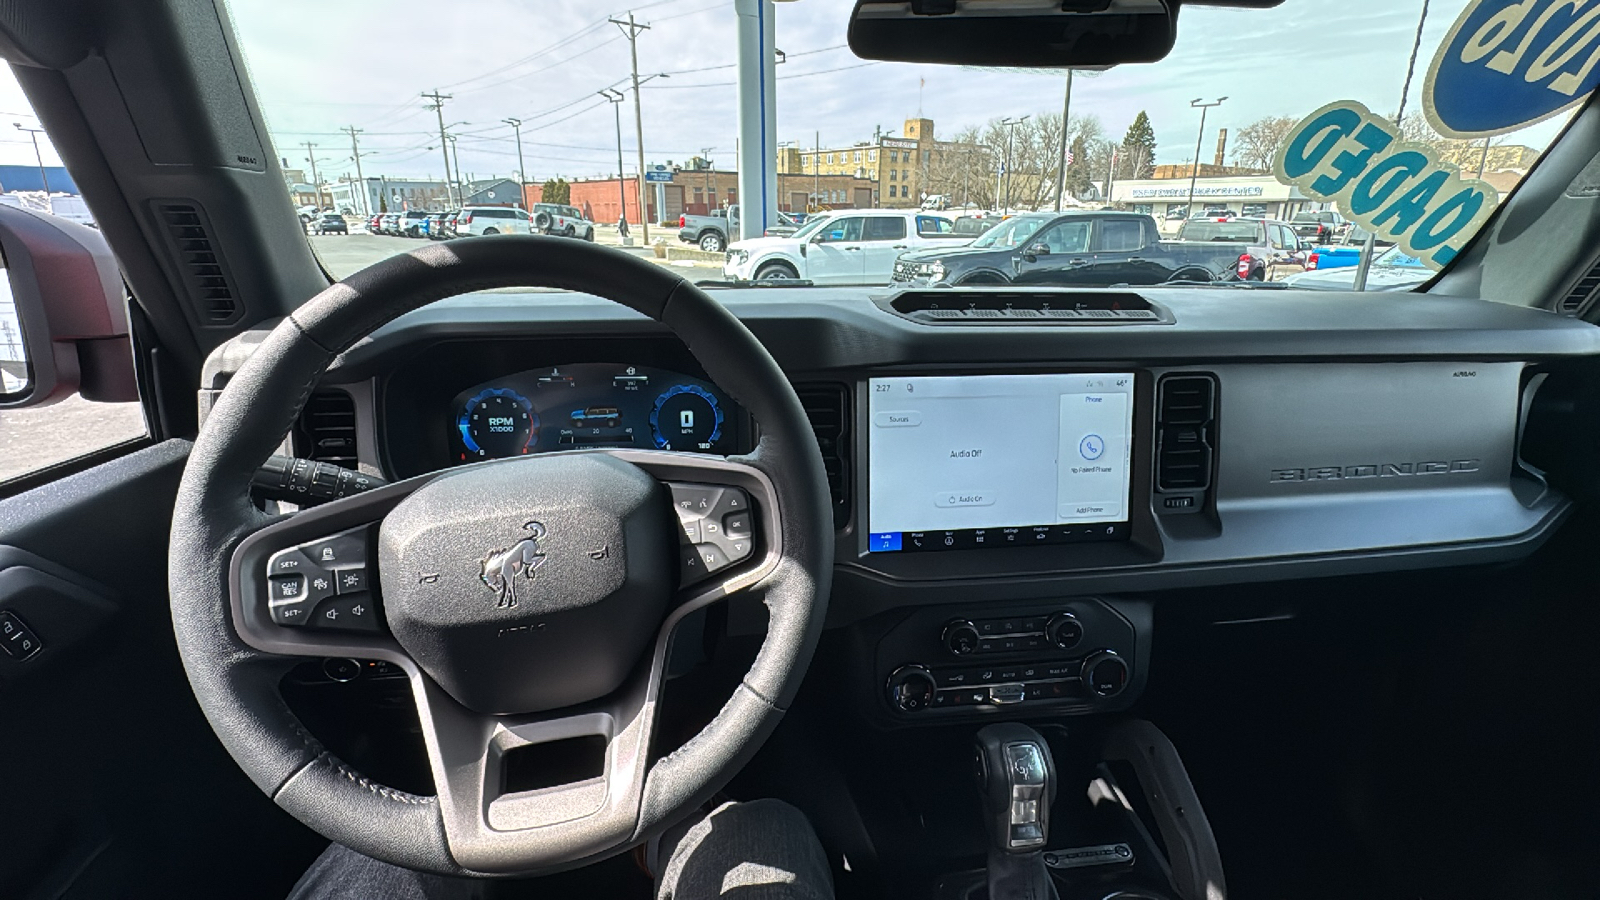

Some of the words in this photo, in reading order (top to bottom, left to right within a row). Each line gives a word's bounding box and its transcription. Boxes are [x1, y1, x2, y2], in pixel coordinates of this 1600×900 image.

[876, 384, 891, 392] 2:27
[488, 416, 514, 426] RPM
[680, 410, 694, 428] 0
[950, 450, 970, 458] Audio
[971, 449, 982, 458] Off
[1270, 458, 1480, 483] BRONCO
